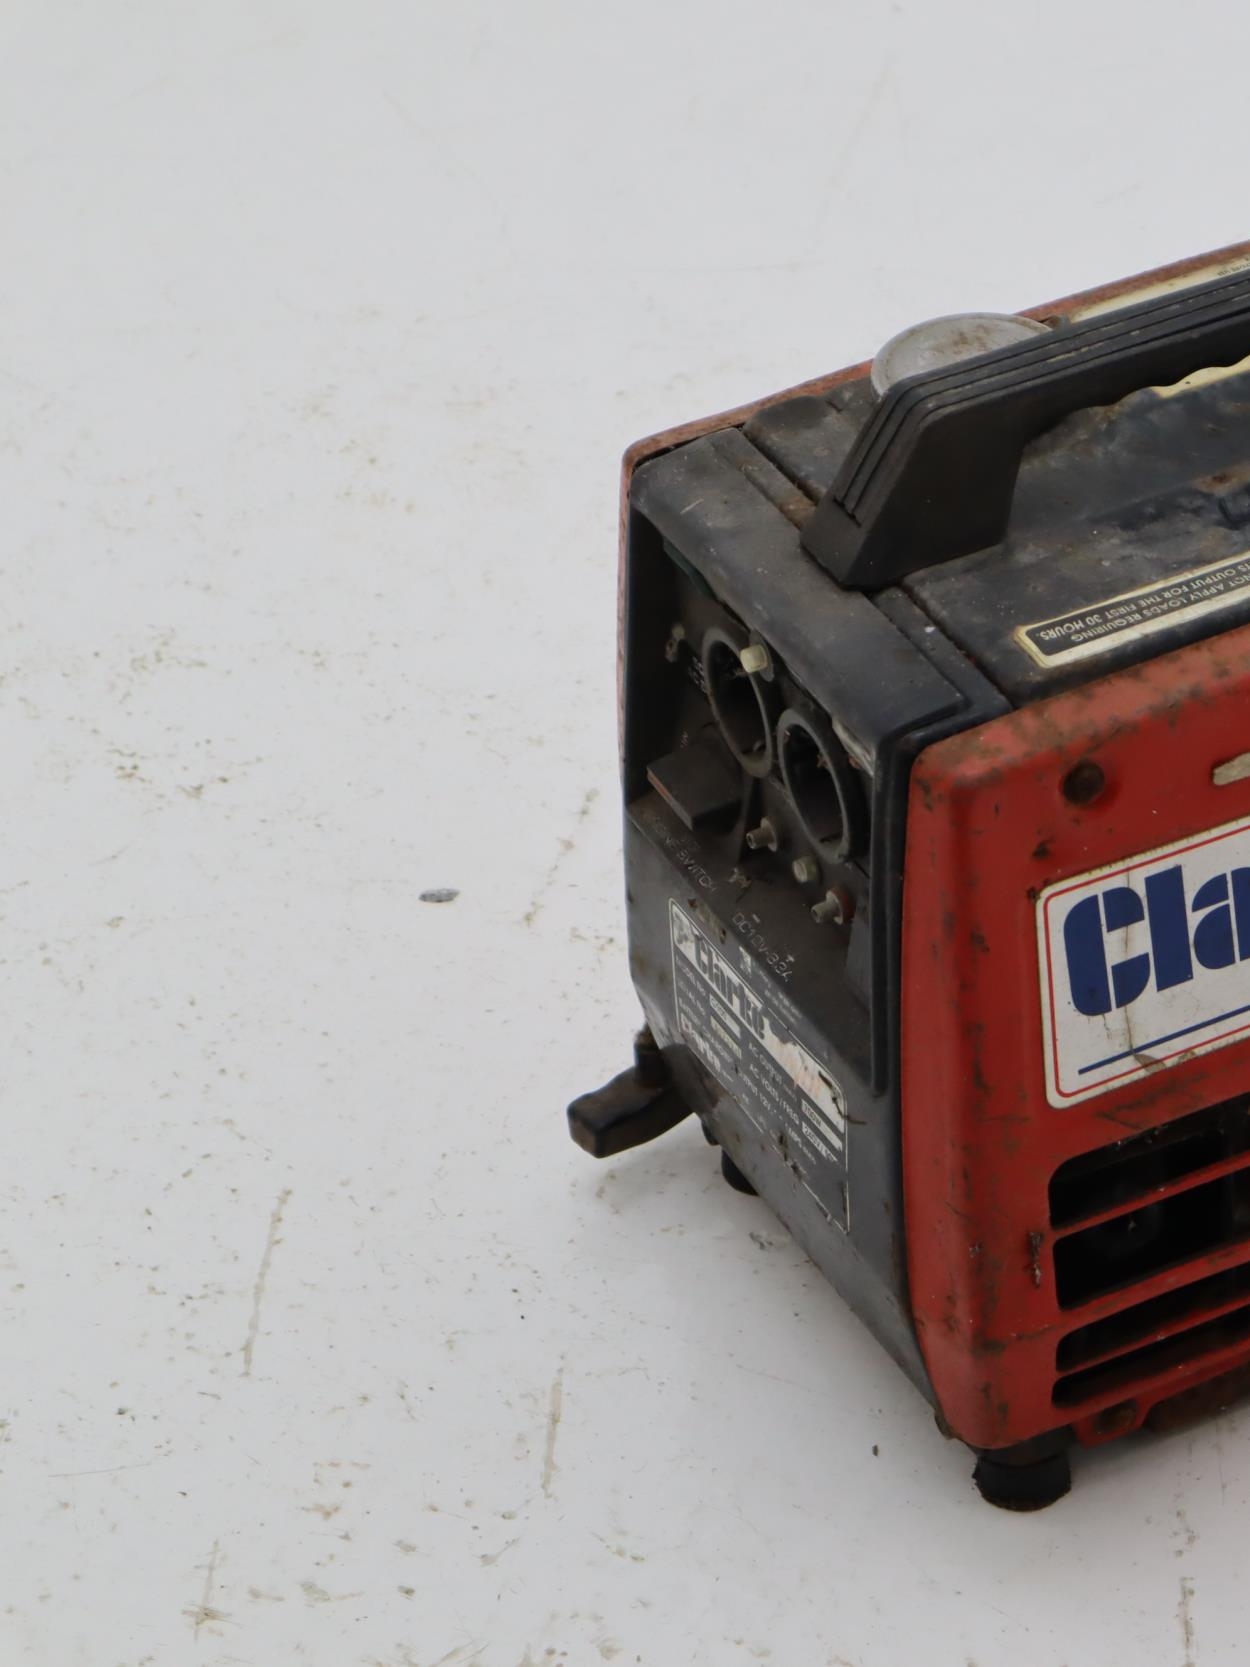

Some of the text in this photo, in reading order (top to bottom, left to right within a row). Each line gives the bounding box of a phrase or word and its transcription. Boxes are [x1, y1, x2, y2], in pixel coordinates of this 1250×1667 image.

[1187, 567, 1238, 589] OUTPUT
[1160, 584, 1190, 599] FOR
[1186, 582, 1227, 600] APPLY
[1135, 593, 1163, 607] THE
[1140, 596, 1188, 617] LOADS
[1101, 602, 1138, 619] FIRST
[1068, 611, 1143, 642] REQUIRING
[1082, 613, 1104, 626] 30
